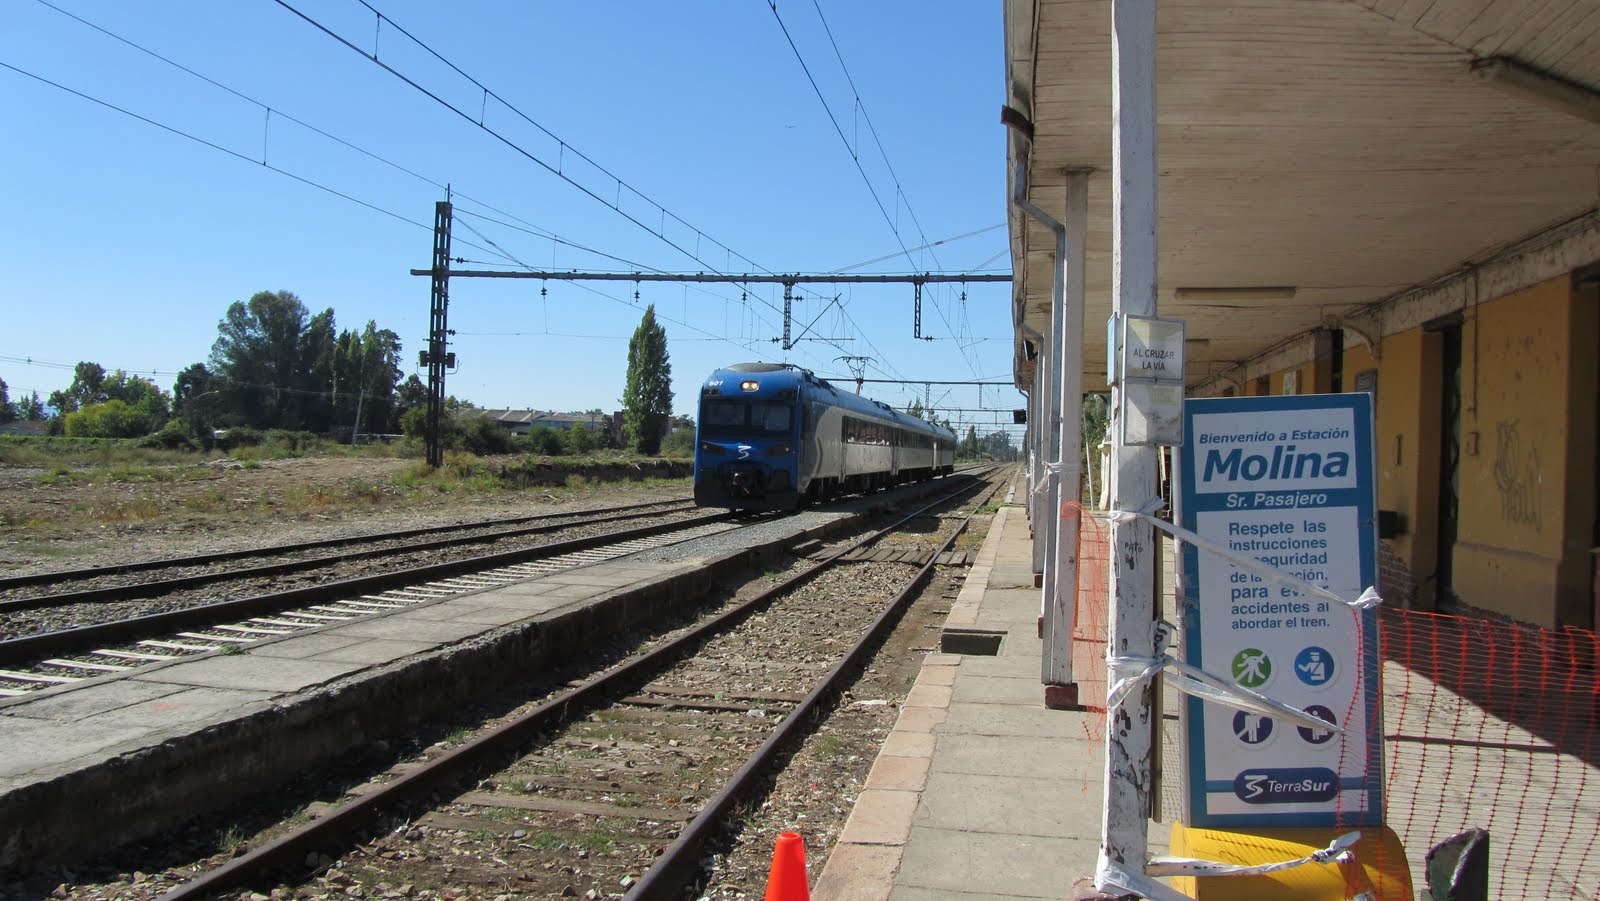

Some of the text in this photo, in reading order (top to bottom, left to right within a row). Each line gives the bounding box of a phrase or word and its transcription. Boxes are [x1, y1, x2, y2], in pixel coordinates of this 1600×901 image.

[1133, 349, 1175, 359] AL CRUZAR
[1142, 361, 1152, 370] LA
[1199, 427, 1350, 444] Bienvenido a Estación
[1202, 445, 1350, 482] Molina
[1226, 492, 1328, 509] Sr. Pasajero
[1229, 520, 1327, 538] Respete las
[1229, 538, 1328, 551] instrucciones
[1254, 552, 1328, 568] eguridad
[1230, 571, 1248, 583] de
[1231, 587, 1268, 602] para
[1231, 602, 1329, 615] accidentes al
[1231, 617, 1331, 630] abordar el tren.
[1268, 779, 1330, 793] TerraSur
